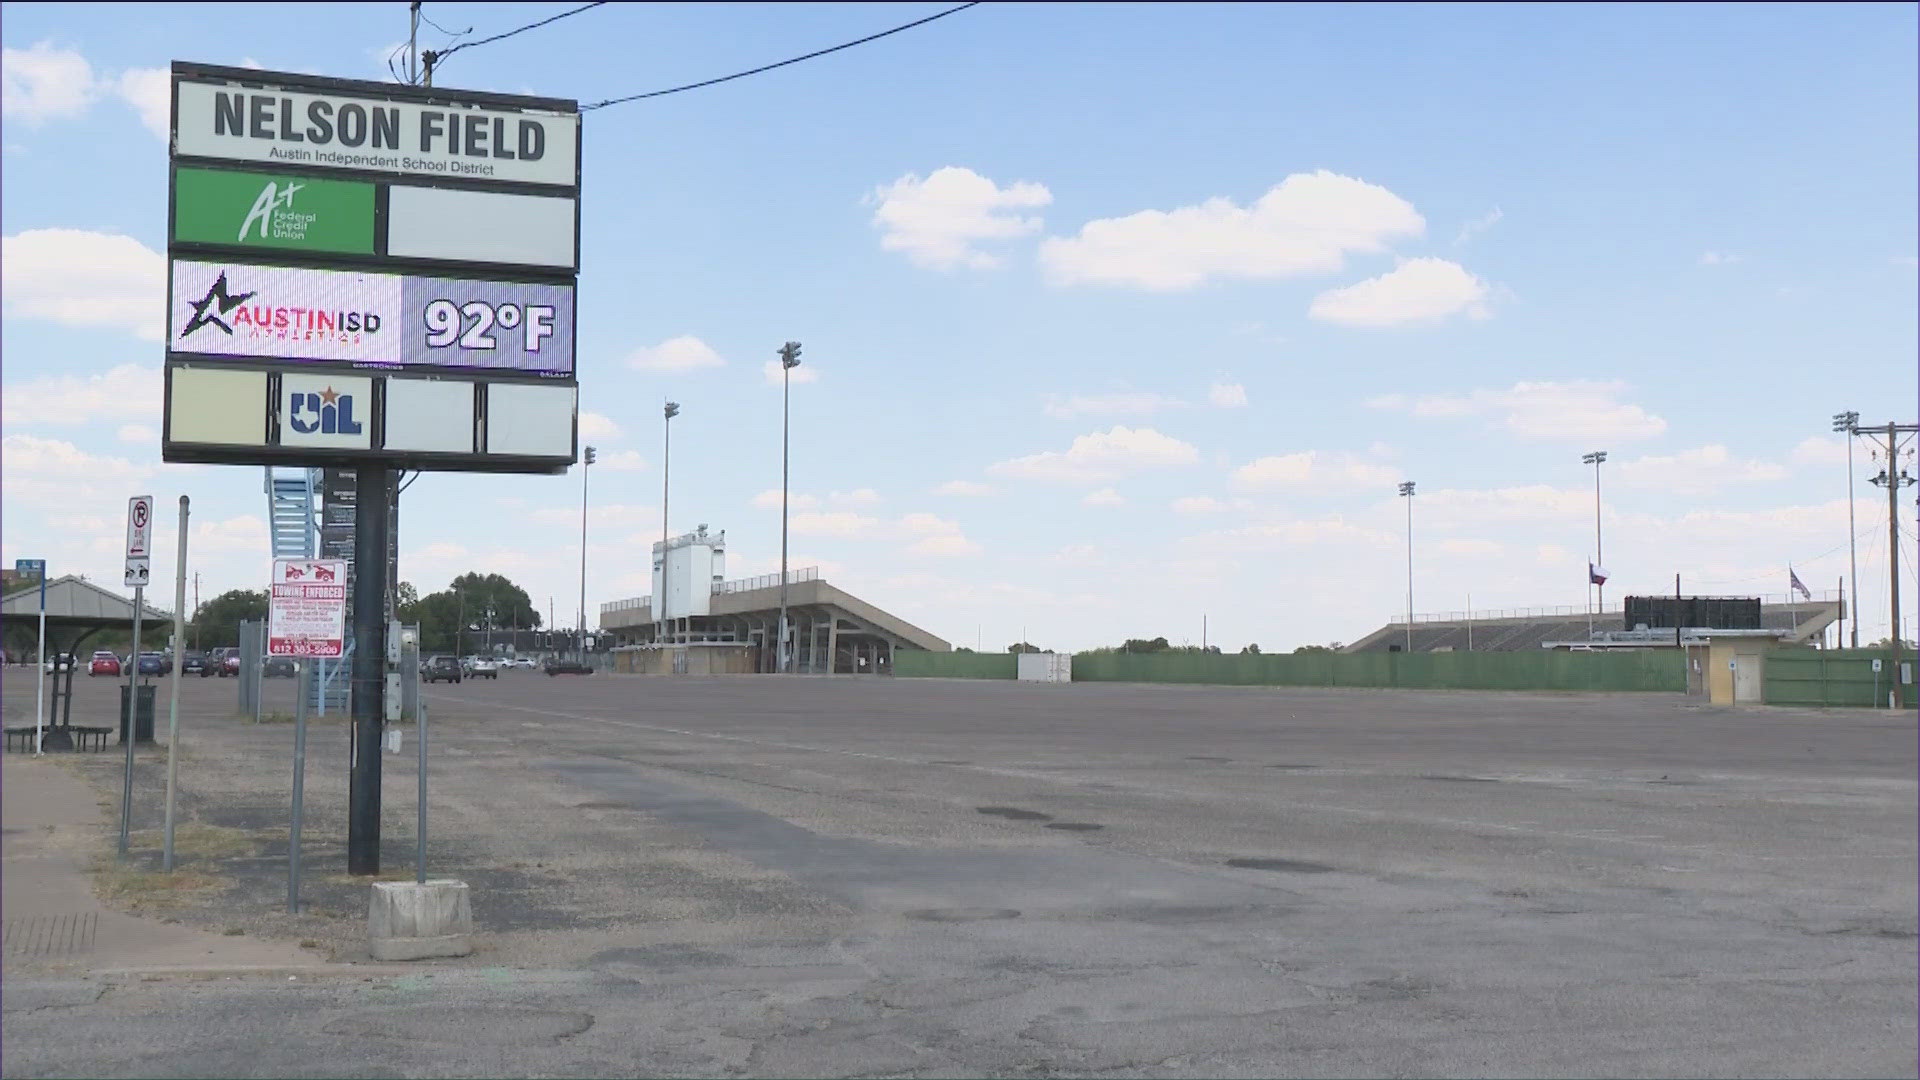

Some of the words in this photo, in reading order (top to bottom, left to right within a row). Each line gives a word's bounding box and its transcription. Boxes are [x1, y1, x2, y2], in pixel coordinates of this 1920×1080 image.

[215, 91, 400, 149] NELSON
[420, 111, 545, 161] FIELD
[269, 147, 311, 161] Austin
[315, 149, 398, 166] Independent
[402, 157, 447, 171] School
[450, 161, 494, 175] District
[238, 181, 305, 241] A+
[274, 209, 317, 222] Federal
[273, 220, 308, 231] Credit
[273, 229, 305, 240] Union
[274, 585, 305, 597] TOWING
[305, 586, 344, 598] ENFORCED
